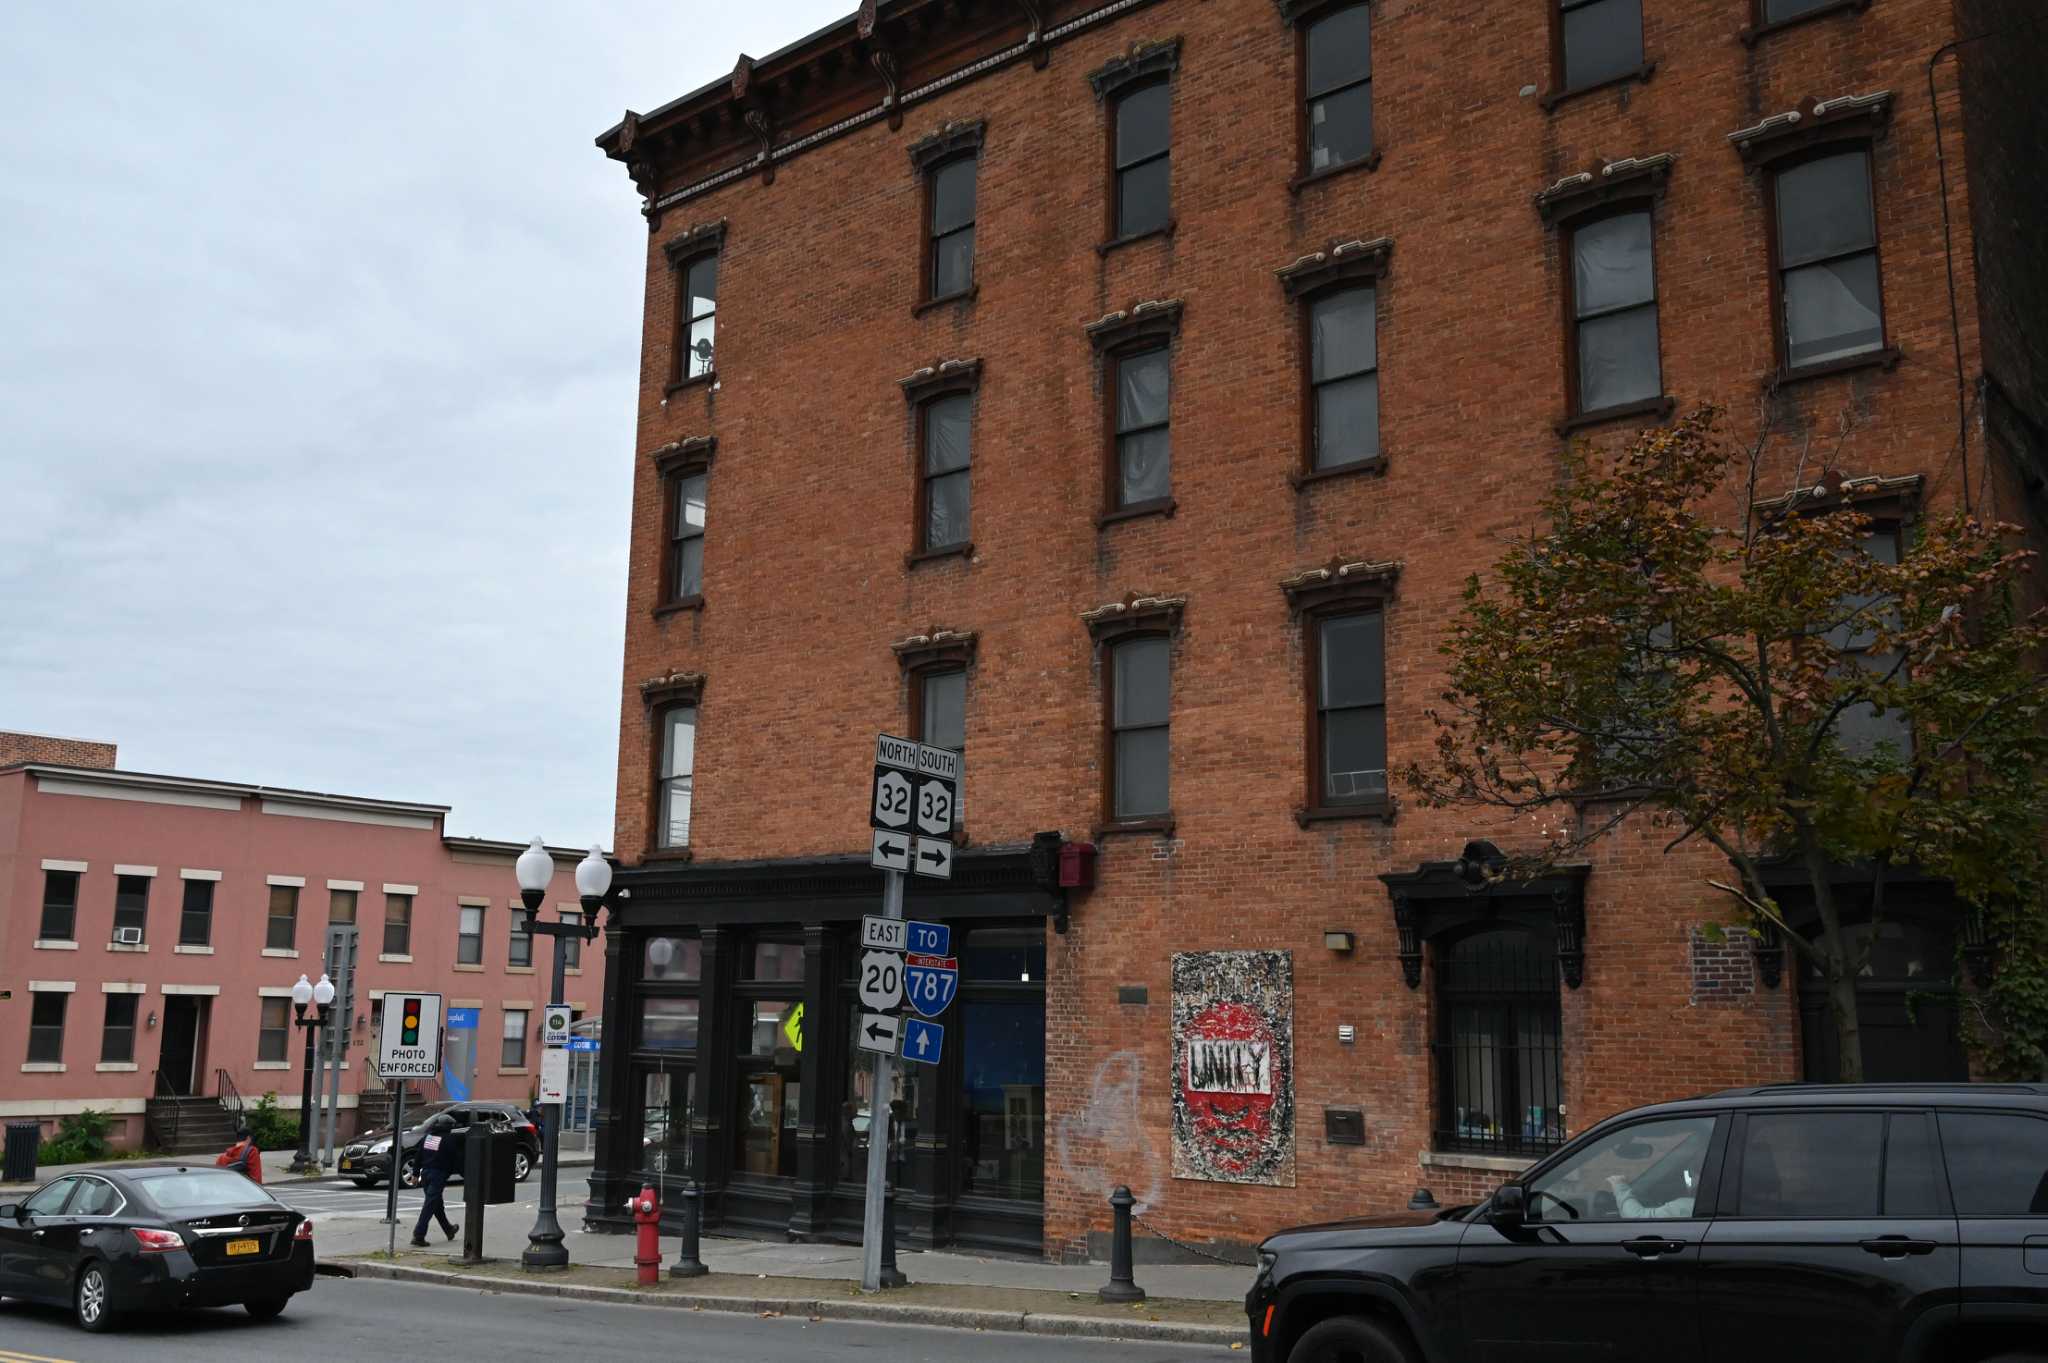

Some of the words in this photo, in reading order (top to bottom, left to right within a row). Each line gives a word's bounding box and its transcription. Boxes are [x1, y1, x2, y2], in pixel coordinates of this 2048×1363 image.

[879, 740, 916, 764] NORTH
[920, 750, 956, 773] SOUTH
[880, 783, 908, 815] 32
[921, 792, 948, 822] 32
[869, 923, 900, 943] EAST
[918, 929, 938, 948] TO
[866, 964, 897, 994] 20
[910, 971, 953, 1002] 787
[391, 1049, 426, 1060] PHOTO
[380, 1062, 435, 1073] ENFORCED
